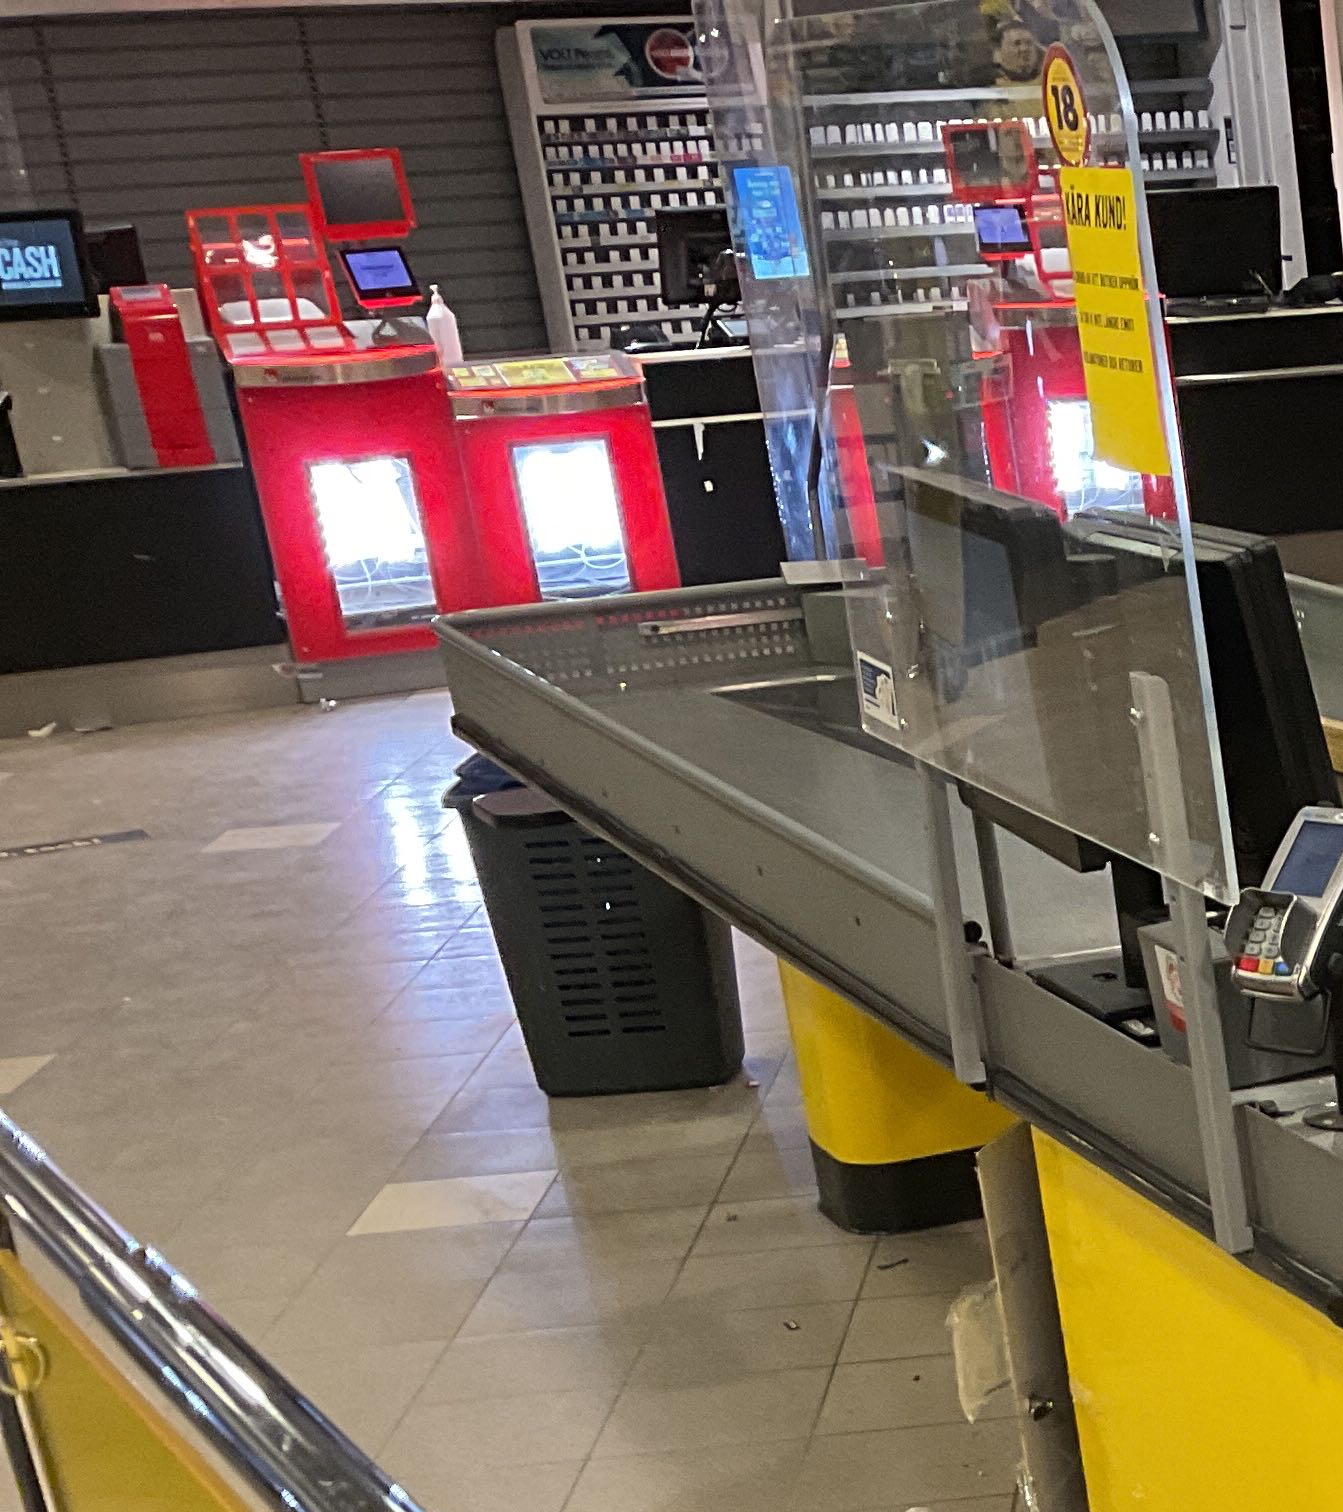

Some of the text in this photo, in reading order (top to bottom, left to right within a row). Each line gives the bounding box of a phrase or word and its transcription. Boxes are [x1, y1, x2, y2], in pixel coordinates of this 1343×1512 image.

[1051, 84, 1079, 132] 18
[1064, 183, 1127, 232] KÄRA KUND!
[0, 244, 61, 281] CASH
